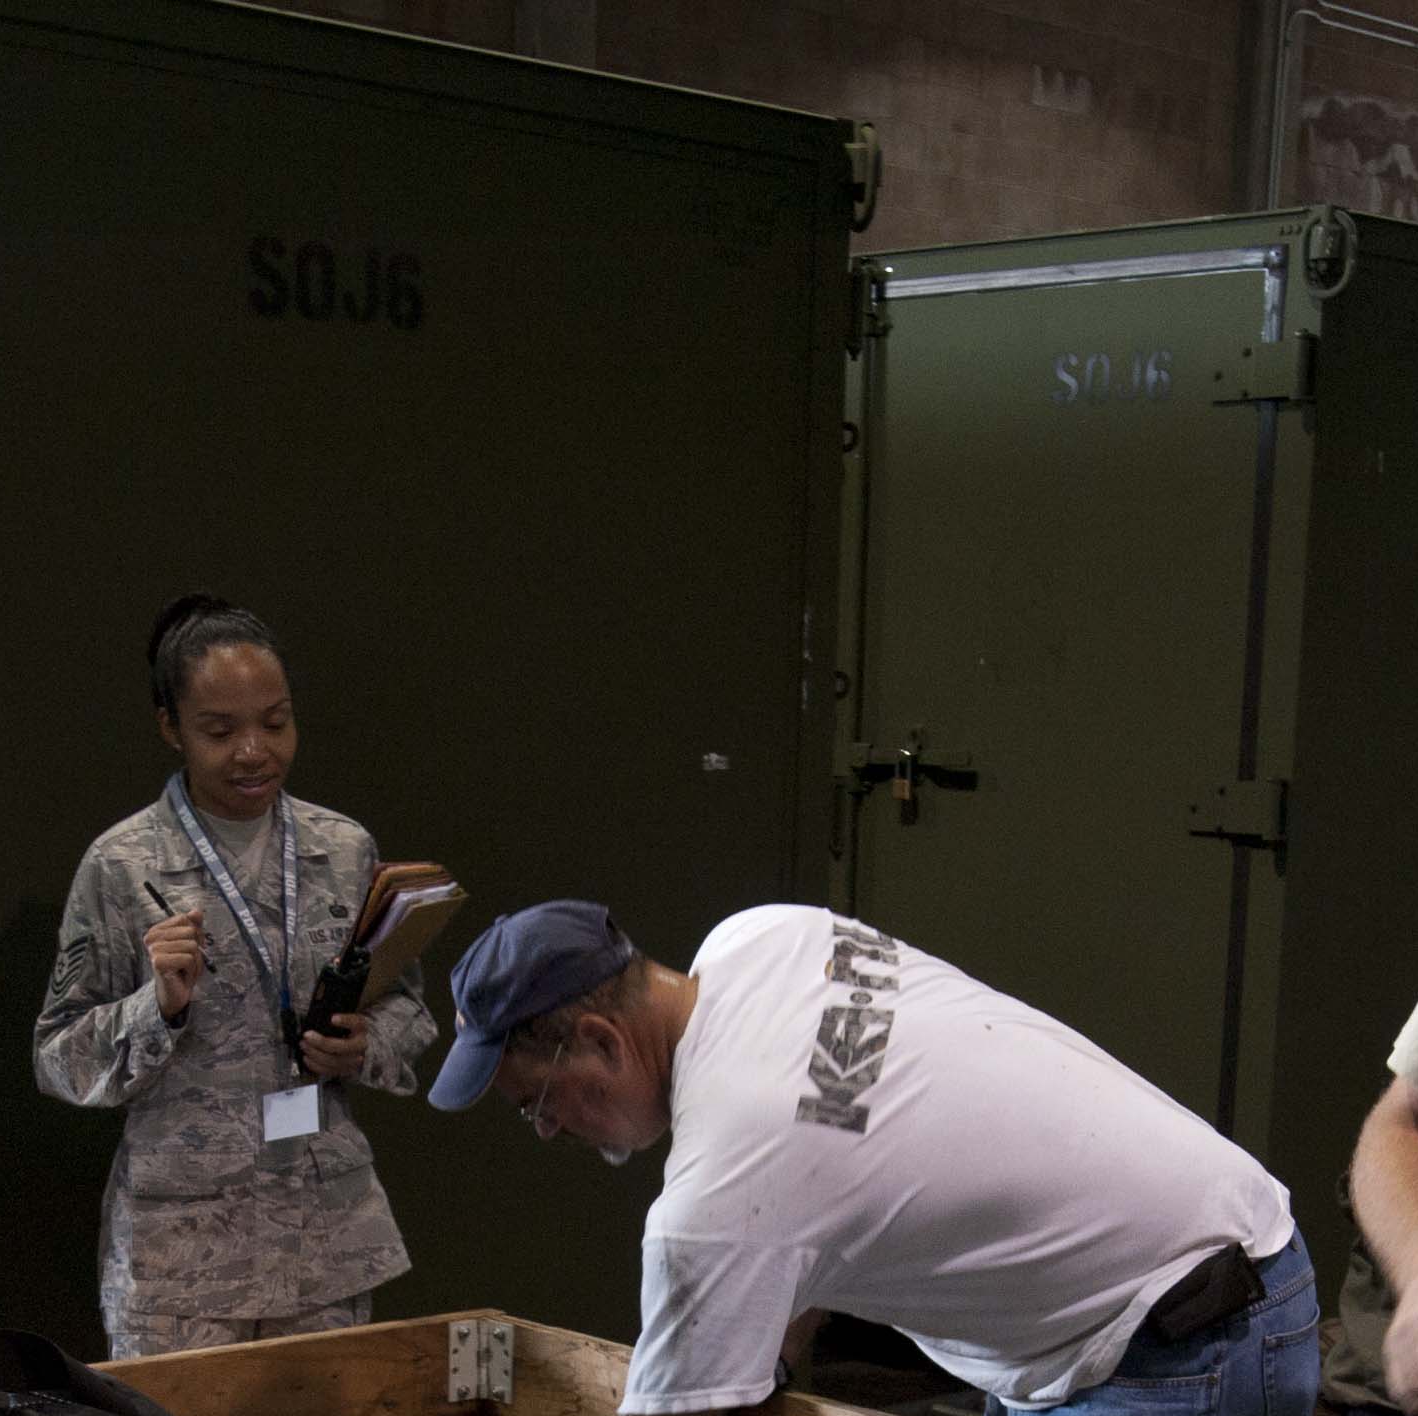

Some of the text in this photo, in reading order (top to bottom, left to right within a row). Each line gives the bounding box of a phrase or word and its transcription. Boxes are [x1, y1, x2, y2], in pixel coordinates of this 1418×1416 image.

[195, 836, 217, 864] PDF
[216, 871, 241, 898] PDF
[238, 908, 260, 935] PDF
